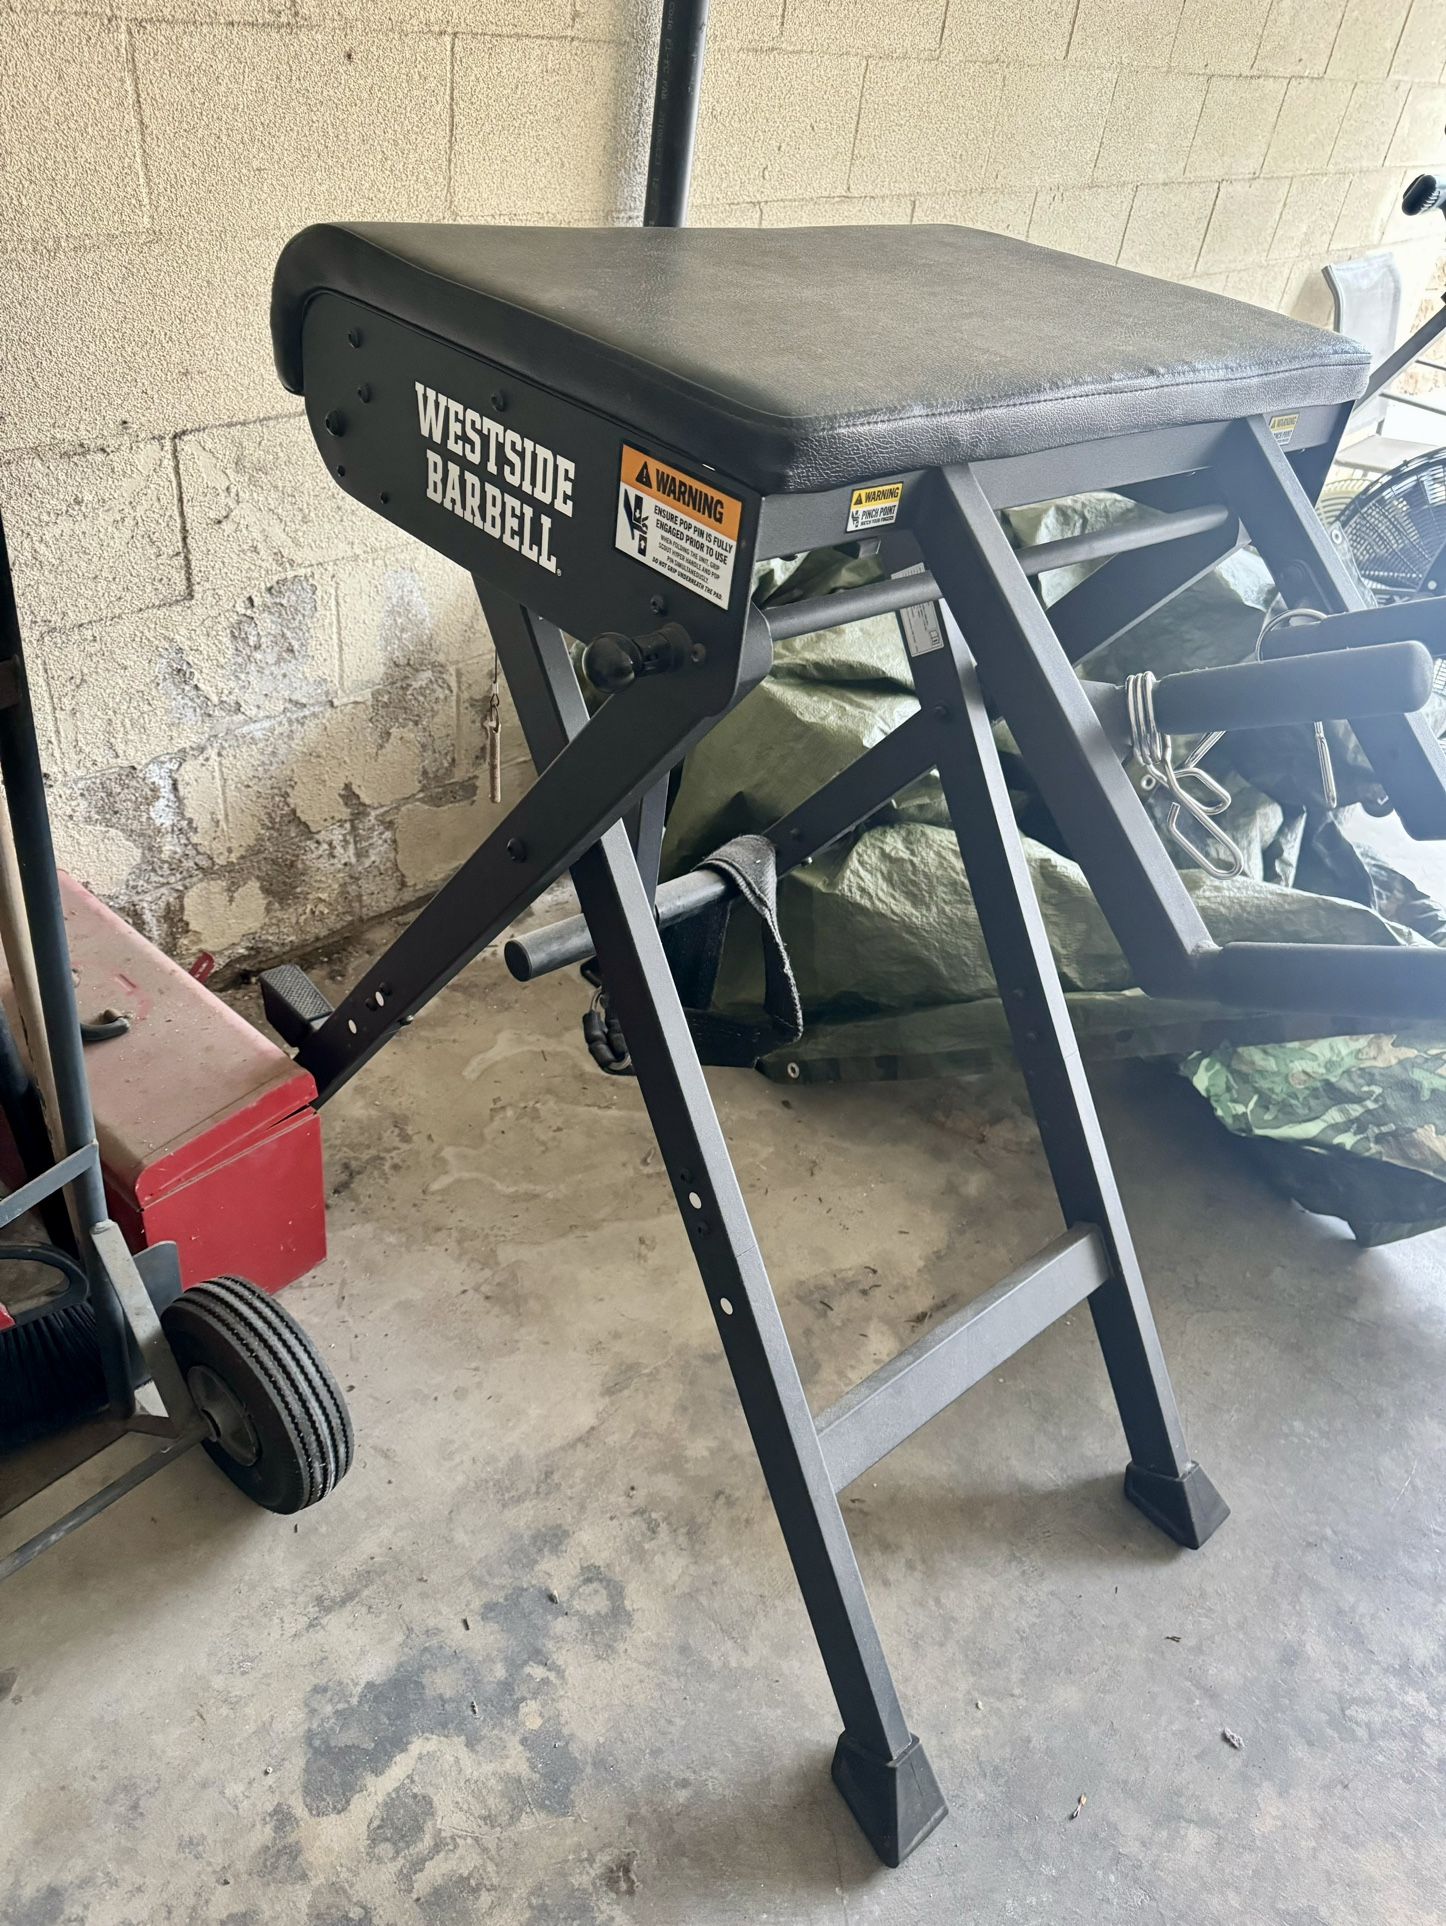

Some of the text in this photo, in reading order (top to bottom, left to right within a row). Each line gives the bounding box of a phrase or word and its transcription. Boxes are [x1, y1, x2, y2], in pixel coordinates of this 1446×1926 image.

[415, 381, 575, 517] WESTSIDE
[426, 449, 557, 574] BARBELL
[656, 468, 724, 524] WARNING
[861, 505, 896, 520] PINCH POINT
[865, 487, 899, 503] WARNING
[654, 505, 733, 554] ENSURE POP PIN IS FULLY
[656, 519, 728, 565] ENGAGED PRIOR TO USE
[658, 542, 720, 579] SCOUT HYPER HANDLE AND POP
[660, 535, 672, 544] WHEN
[673, 540, 690, 555] FOLDING
[710, 561, 720, 570] GRIP
[652, 556, 658, 564] DO
[659, 560, 667, 569] NOT
[667, 564, 677, 574] GRIP
[678, 570, 704, 590] UNDERNEATH
[705, 585, 713, 595] THE
